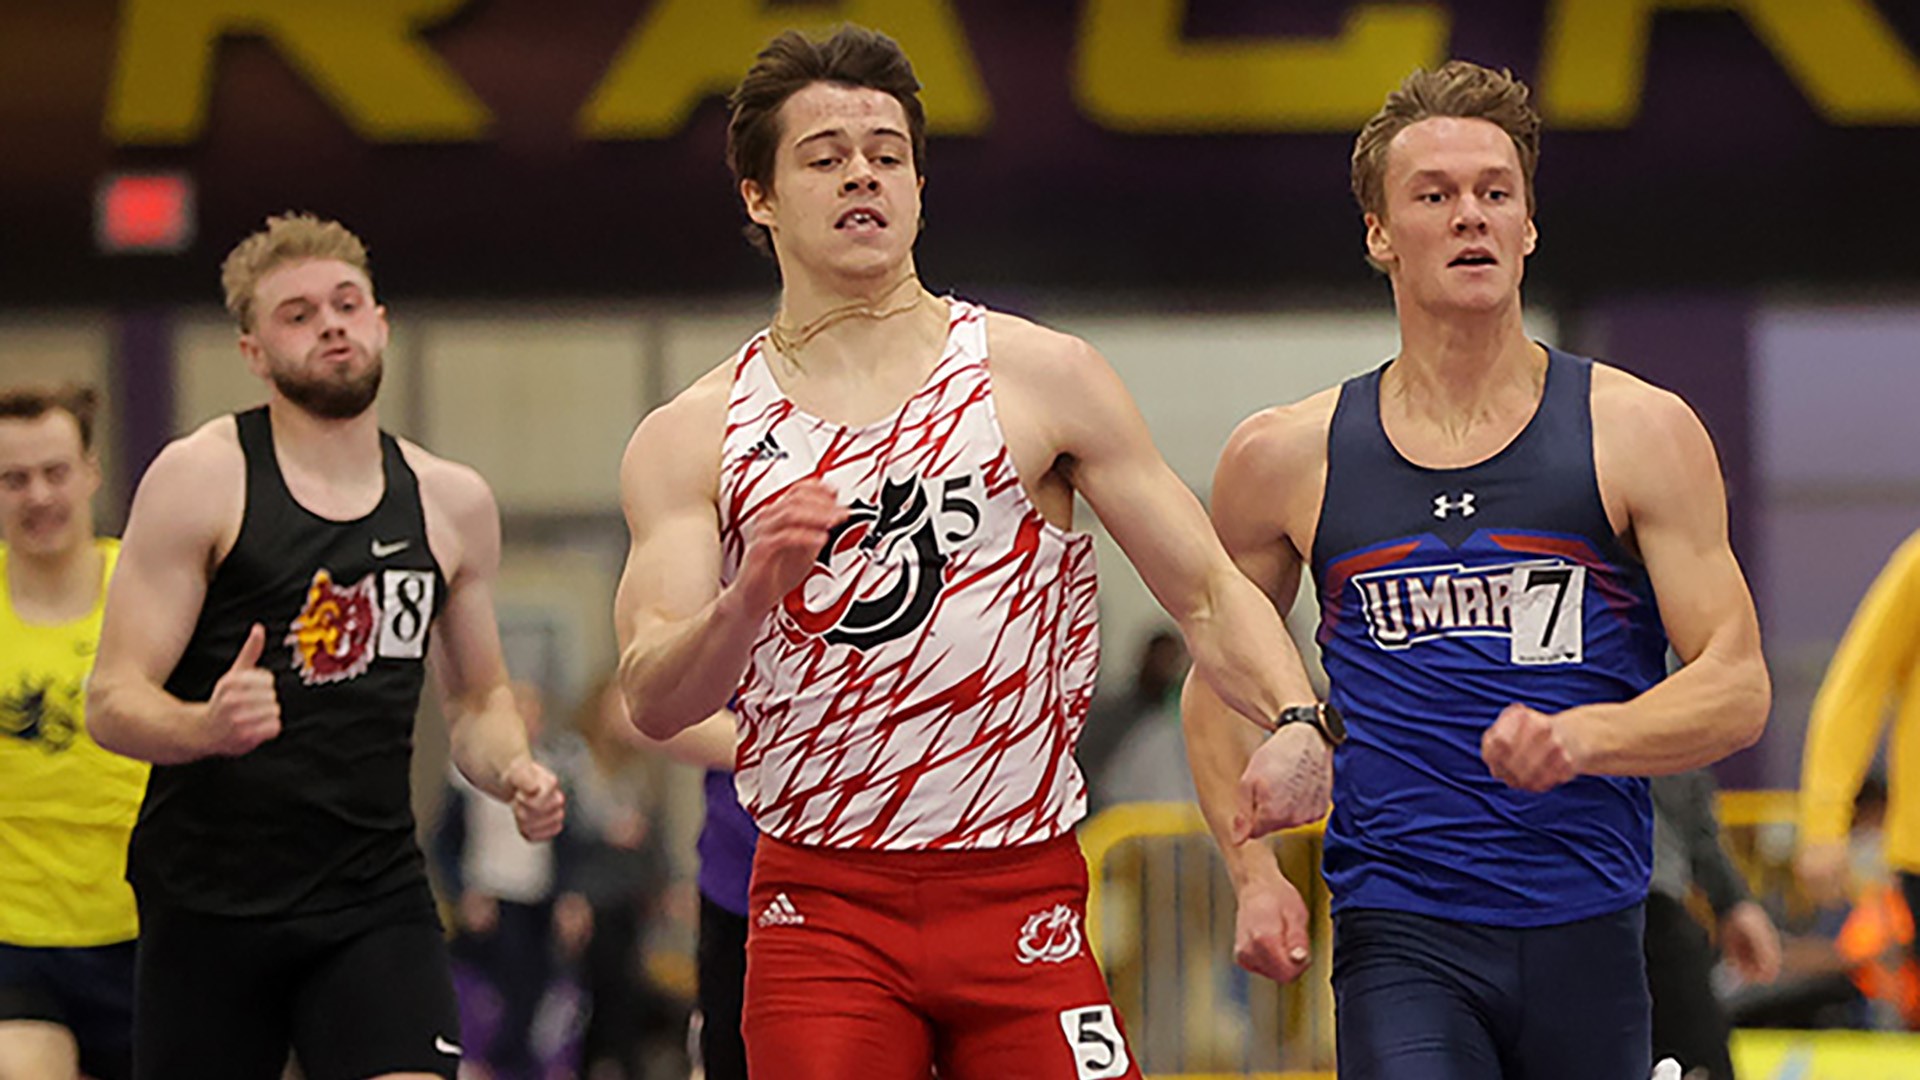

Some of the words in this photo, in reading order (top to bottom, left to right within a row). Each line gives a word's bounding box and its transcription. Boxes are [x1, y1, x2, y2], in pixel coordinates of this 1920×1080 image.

[941, 475, 980, 542] 5
[392, 576, 425, 643] 8
[1364, 574, 1512, 640] UMAR
[1525, 569, 1572, 648] 7
[1078, 1011, 1115, 1070] 5
